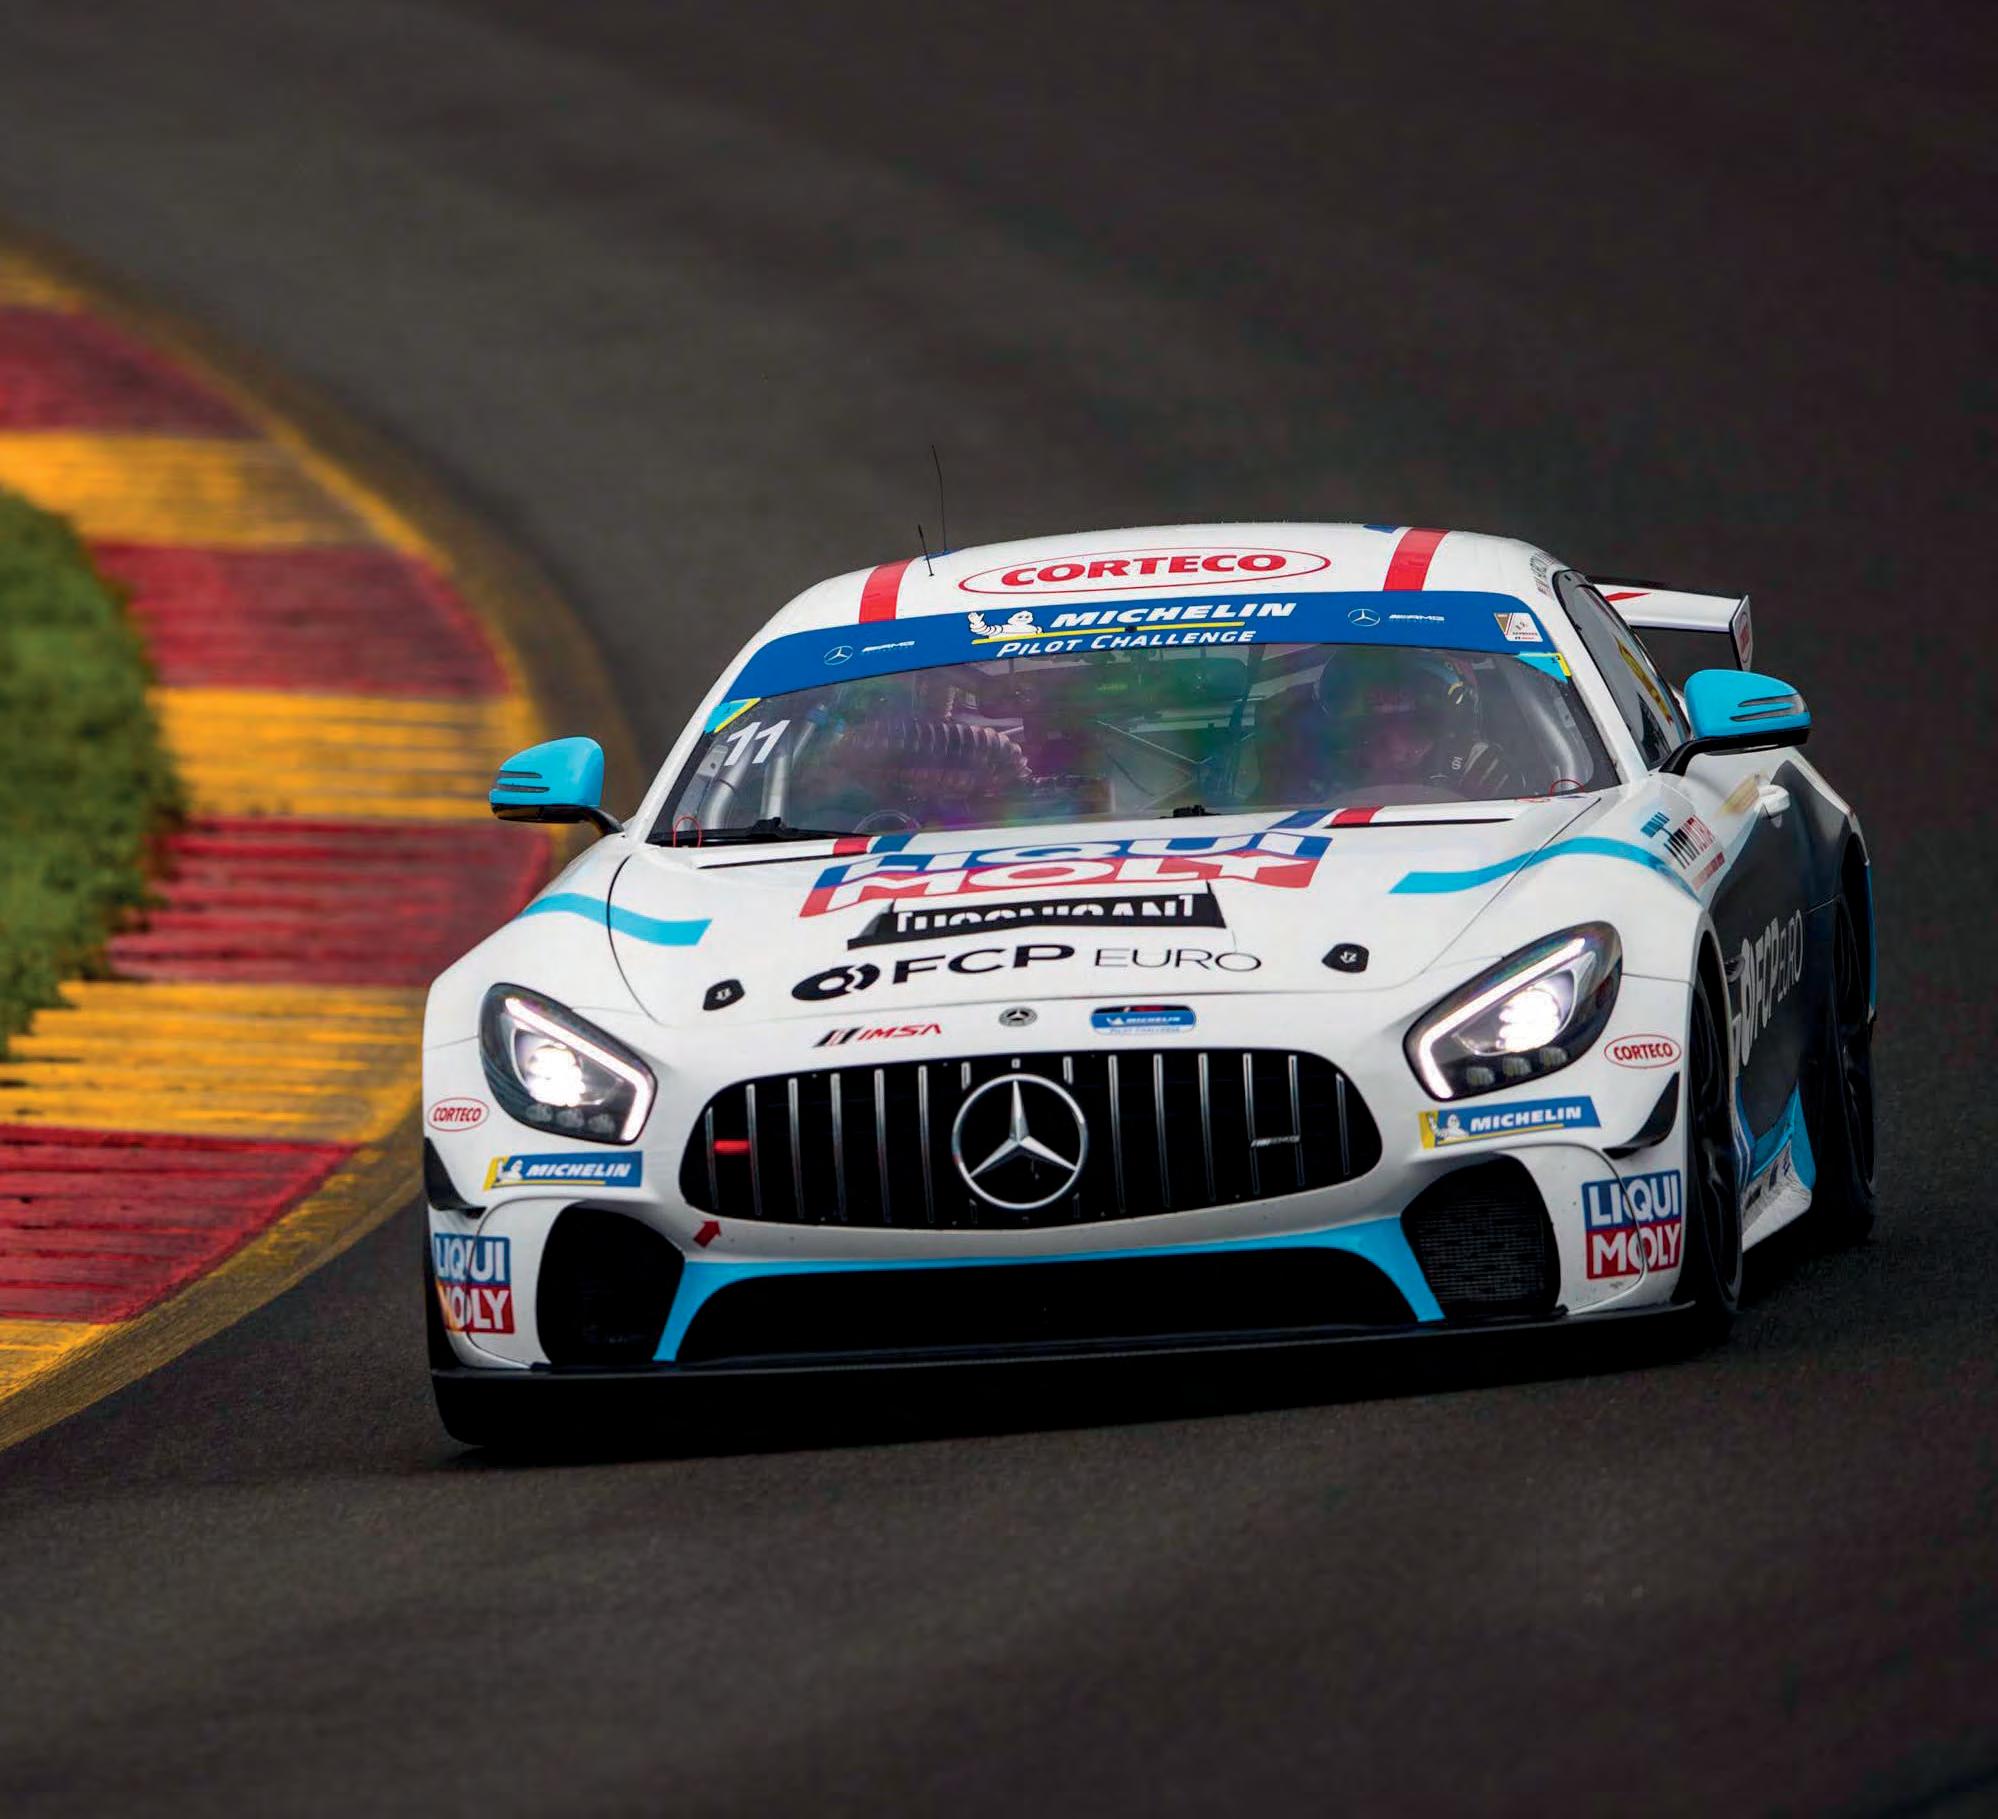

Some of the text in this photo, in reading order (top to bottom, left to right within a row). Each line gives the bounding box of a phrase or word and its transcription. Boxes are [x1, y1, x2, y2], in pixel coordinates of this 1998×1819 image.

[1000, 554, 1287, 586] CORTECO
[1050, 603, 1297, 628] MICHELIN
[996, 630, 1256, 657] PILOT CHALLENGE
[724, 719, 791, 766] 11
[840, 832, 1303, 884] LIQUI
[824, 855, 1314, 912] MOLY
[892, 944, 1262, 983] FCP EURO
[857, 1023, 942, 1040] IMSA
[1613, 1042, 1674, 1061] CORTECO
[433, 1107, 482, 1122] CORTECO
[1470, 1106, 1582, 1132] MICHELIN
[526, 1162, 632, 1178] MICHELIN
[1589, 1174, 1680, 1227] LIQUI
[1593, 1223, 1682, 1275] MOLY
